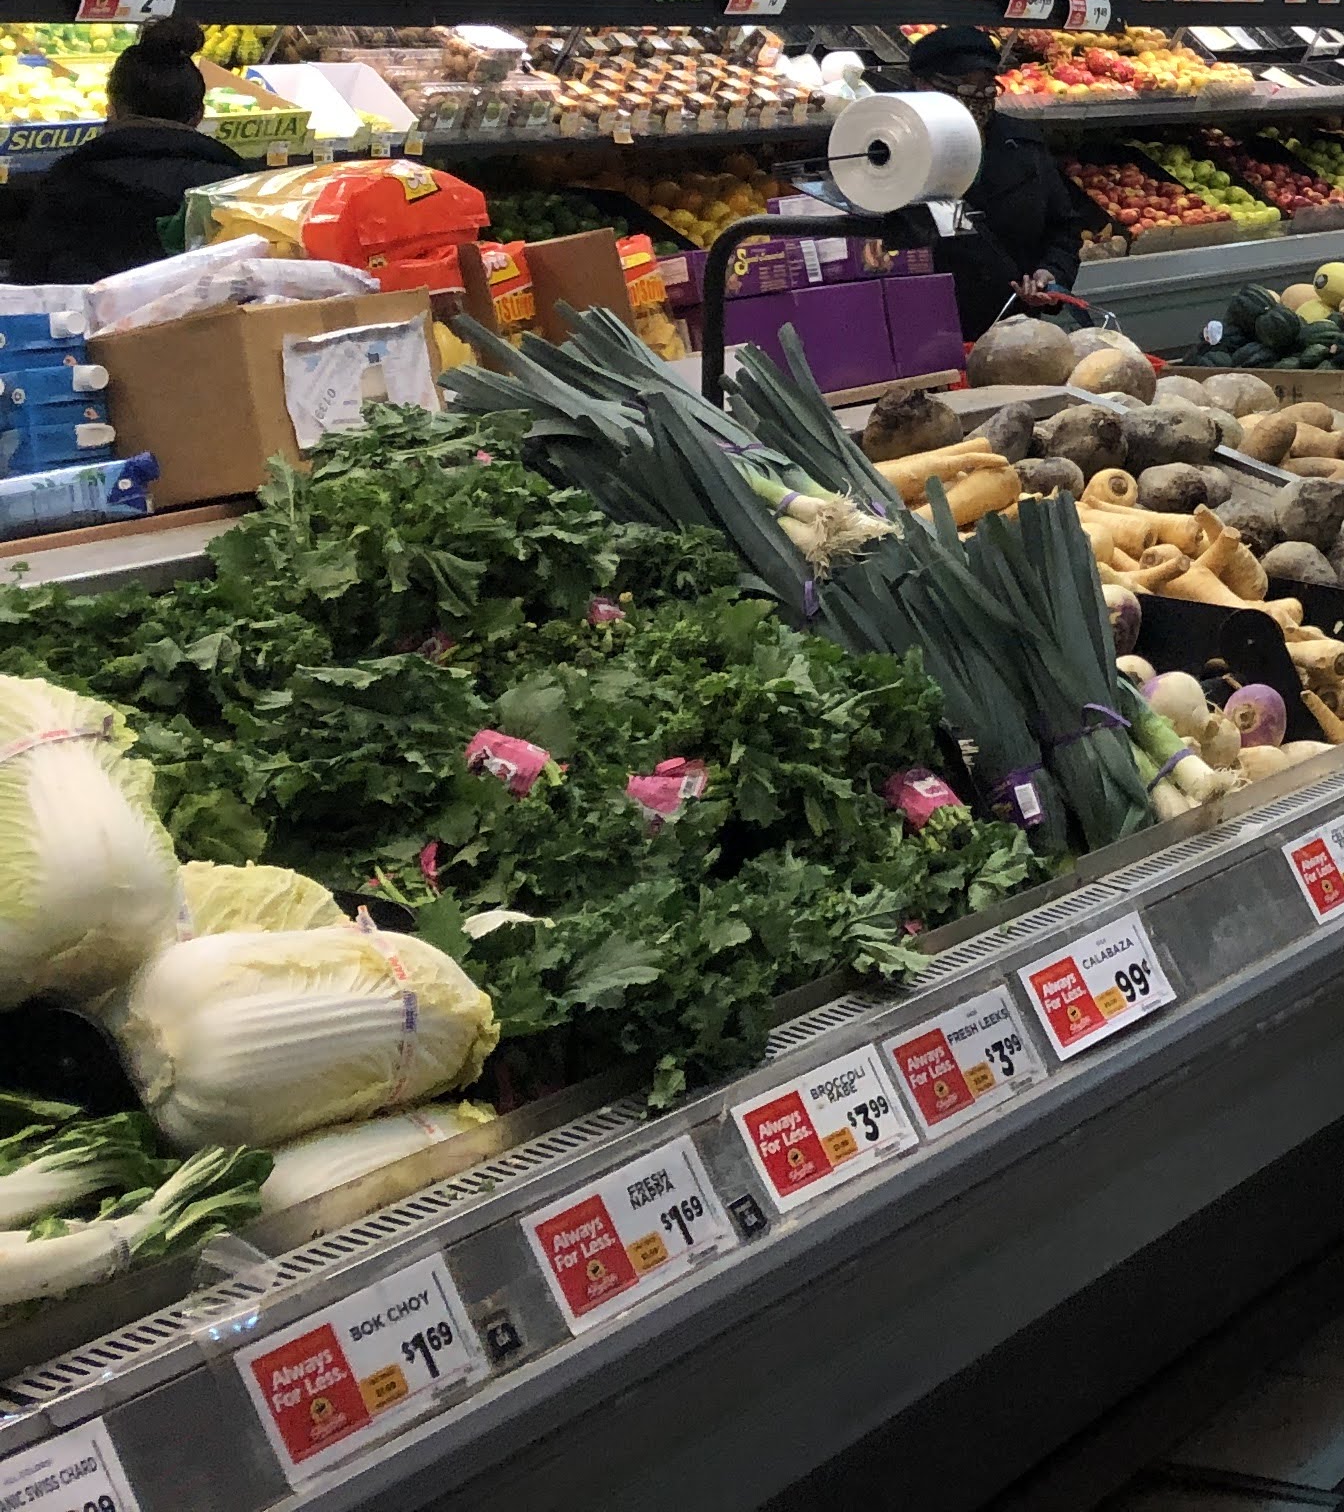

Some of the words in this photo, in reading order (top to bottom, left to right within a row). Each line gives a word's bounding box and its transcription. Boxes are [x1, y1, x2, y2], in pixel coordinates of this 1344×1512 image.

[8, 126, 99, 150] SICILIA
[215, 117, 298, 140] SICILIA
[1302, 851, 1328, 873] Always
[1082, 937, 1134, 970] CALABAZA
[1042, 972, 1077, 999] Always
[1115, 958, 1151, 1003] 99¢
[1044, 996, 1062, 1013] For
[1061, 985, 1087, 1004] Less.
[947, 1022, 978, 1045] FRESH
[978, 1007, 1010, 1031] LEEKS
[907, 1045, 945, 1072] Always
[985, 1033, 1022, 1076] $399
[810, 1066, 866, 1100] BROCCOLI
[909, 1071, 928, 1089] For
[928, 1060, 955, 1079] Less.
[827, 1083, 858, 1104] RABE
[758, 1110, 802, 1140] Always
[847, 1096, 889, 1141] $399
[759, 1138, 782, 1158] For
[781, 1125, 813, 1146] Less.
[627, 1168, 668, 1196] FRESH
[630, 1182, 677, 1210] NAPPA
[552, 1215, 604, 1253] Always
[660, 1195, 703, 1246] $169
[554, 1254, 579, 1272] For
[580, 1231, 616, 1260] Less.
[349, 1314, 385, 1342] BOK
[386, 1289, 430, 1322] CHOY
[401, 1321, 454, 1379] $169
[272, 1349, 334, 1392] Always
[272, 1390, 302, 1414] For
[304, 1366, 348, 1396] Less.
[25, 1475, 60, 1502] SWISS
[60, 1457, 98, 1485] CHARD
